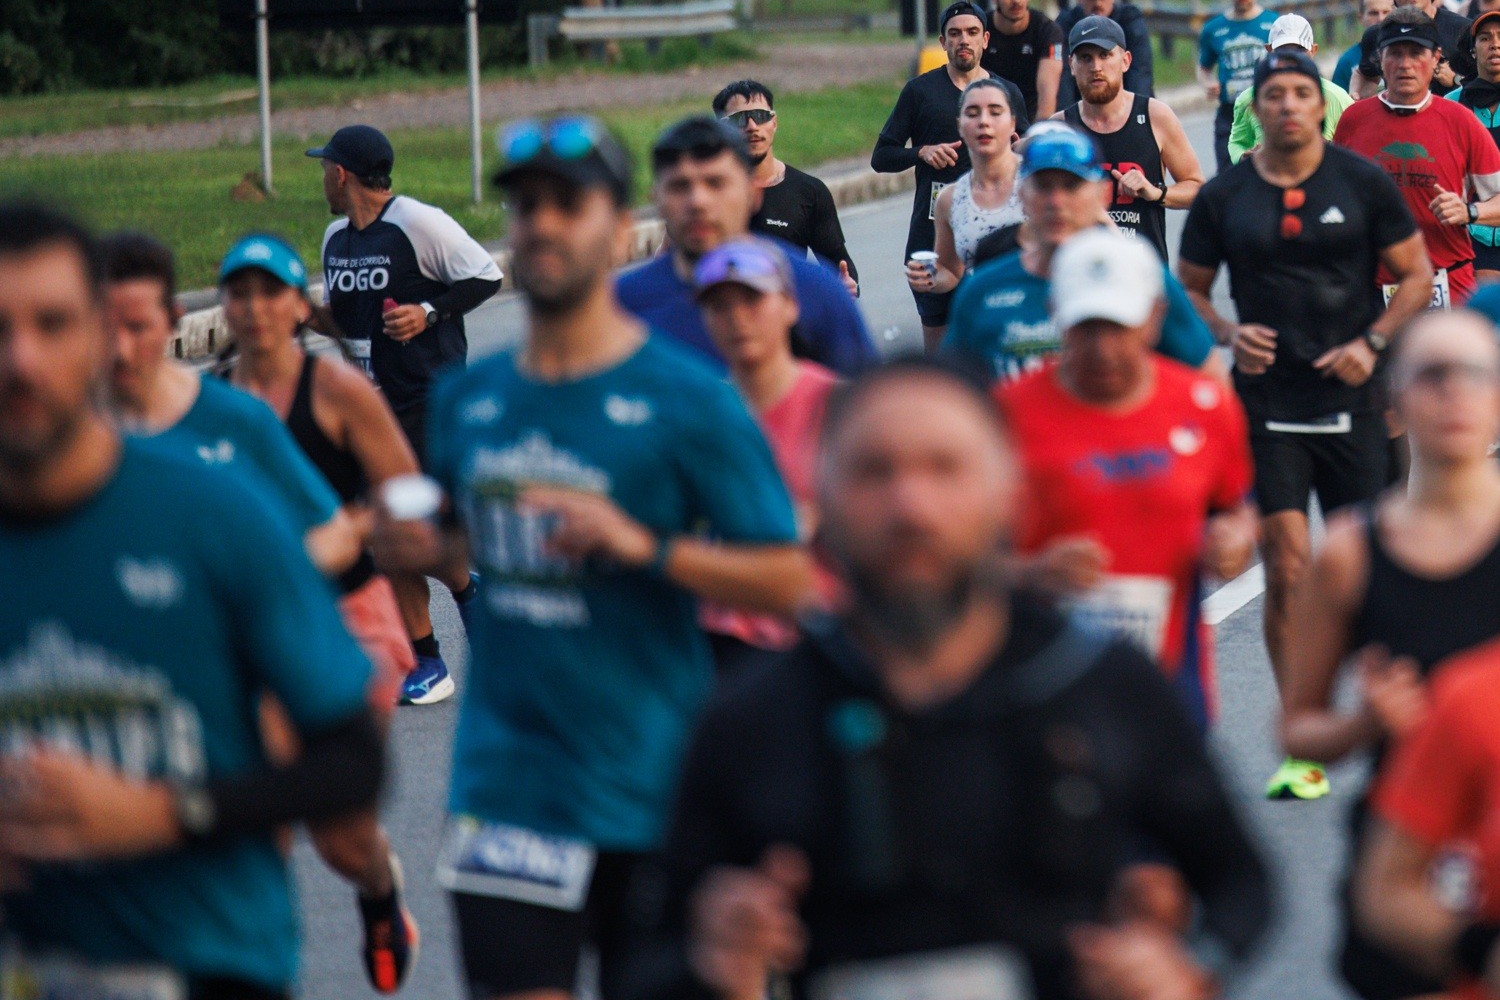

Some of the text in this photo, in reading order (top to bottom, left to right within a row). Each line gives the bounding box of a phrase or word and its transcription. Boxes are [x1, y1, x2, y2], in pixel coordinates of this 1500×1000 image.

[349, 258, 358, 268] DE
[359, 255, 391, 268] CORRIDA
[327, 267, 389, 293] VOGO
